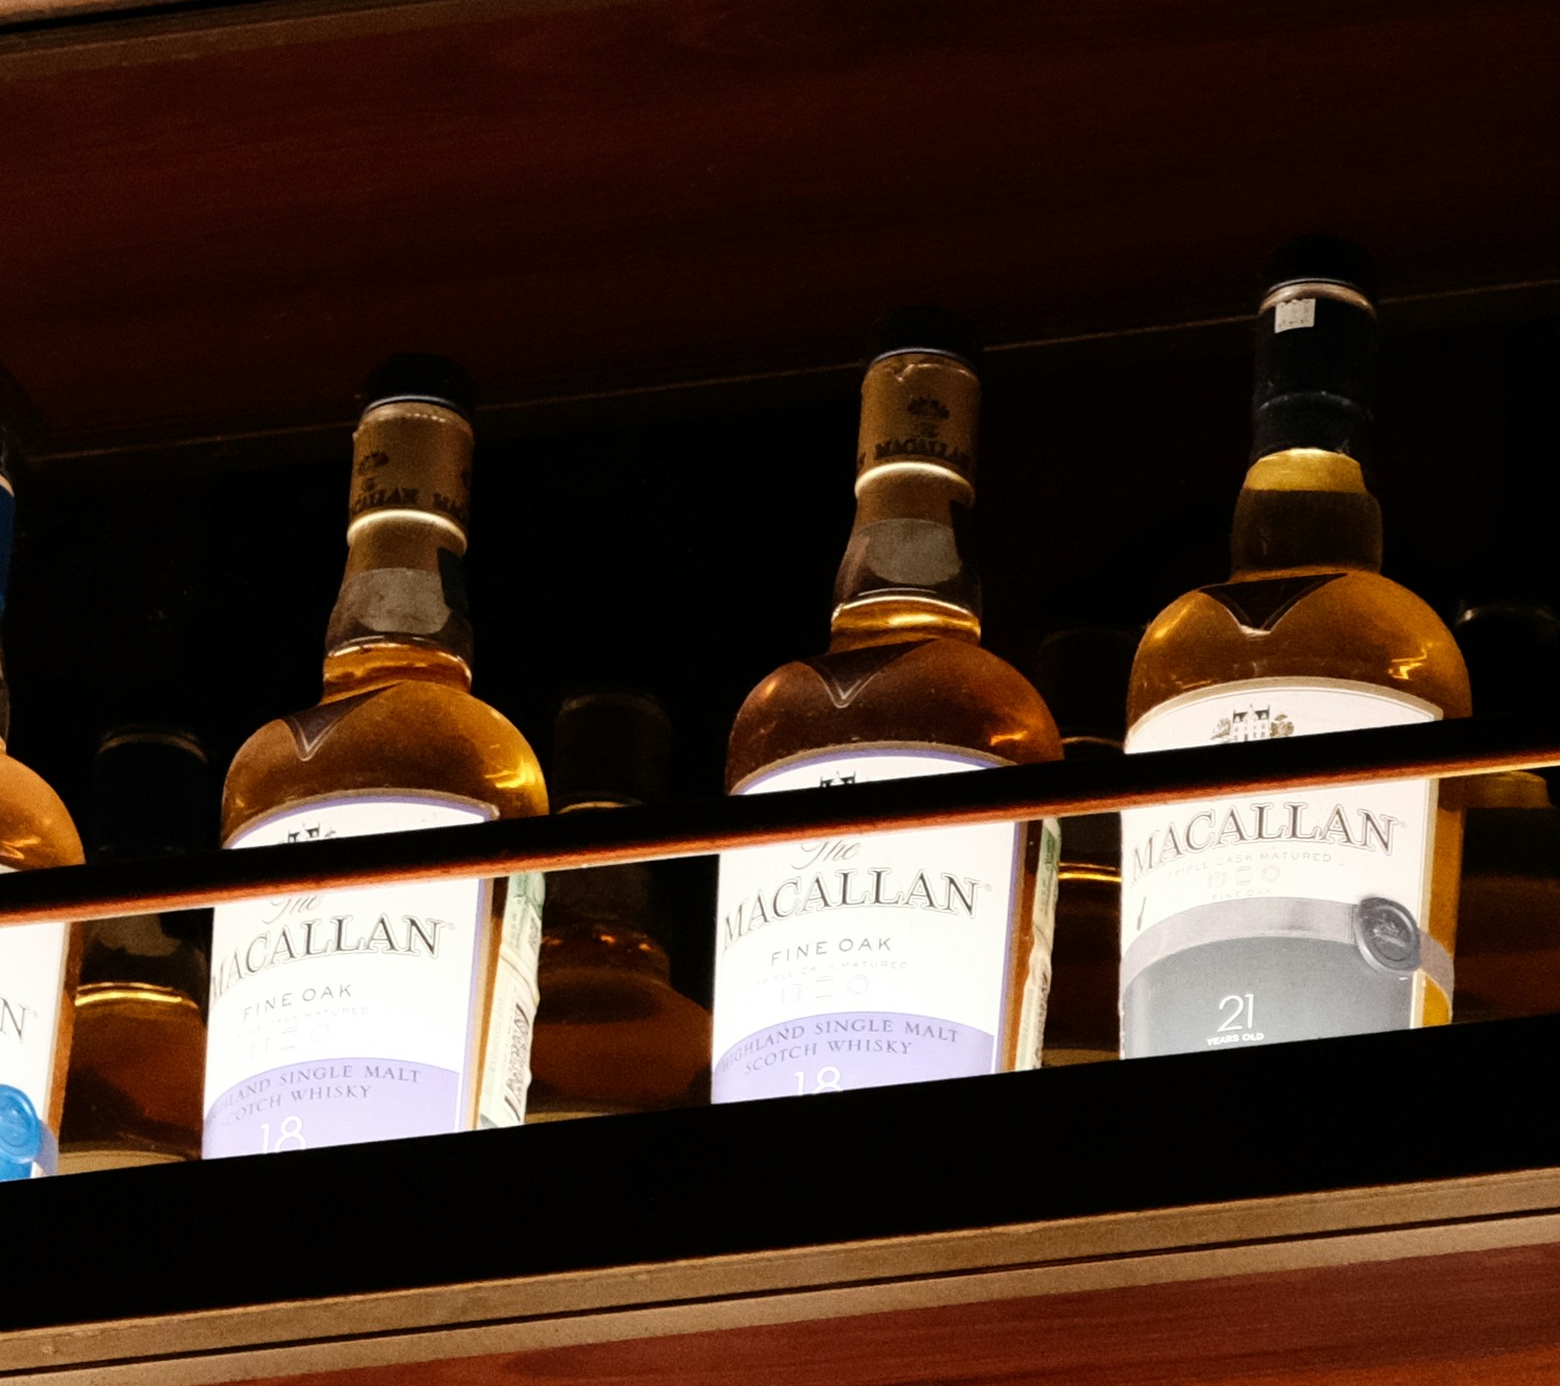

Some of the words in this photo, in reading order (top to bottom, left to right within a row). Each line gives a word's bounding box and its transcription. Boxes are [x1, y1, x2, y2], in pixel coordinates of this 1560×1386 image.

[790, 839, 861, 870] The
[1131, 801, 1397, 887] MACALLAN
[1216, 854, 1253, 866] CASK
[1259, 851, 1332, 863] MATURED
[721, 867, 980, 957] MACALLAN
[770, 940, 829, 967] FINE
[837, 937, 893, 954] OAK
[242, 990, 293, 1021] FINE
[301, 983, 353, 1003] OAK
[1216, 991, 1256, 1033] 21
[813, 1018, 894, 1035] SINGLE
[904, 1021, 959, 1044] MALT
[1206, 1033, 1240, 1046] YEARS
[1241, 1031, 1266, 1043] OLD
[744, 1043, 818, 1077] SCOTCH
[827, 1039, 913, 1056] WHISKY
[280, 1065, 353, 1086] SINGLE
[365, 1065, 421, 1084] MALT
[290, 1084, 372, 1103] WHISKY
